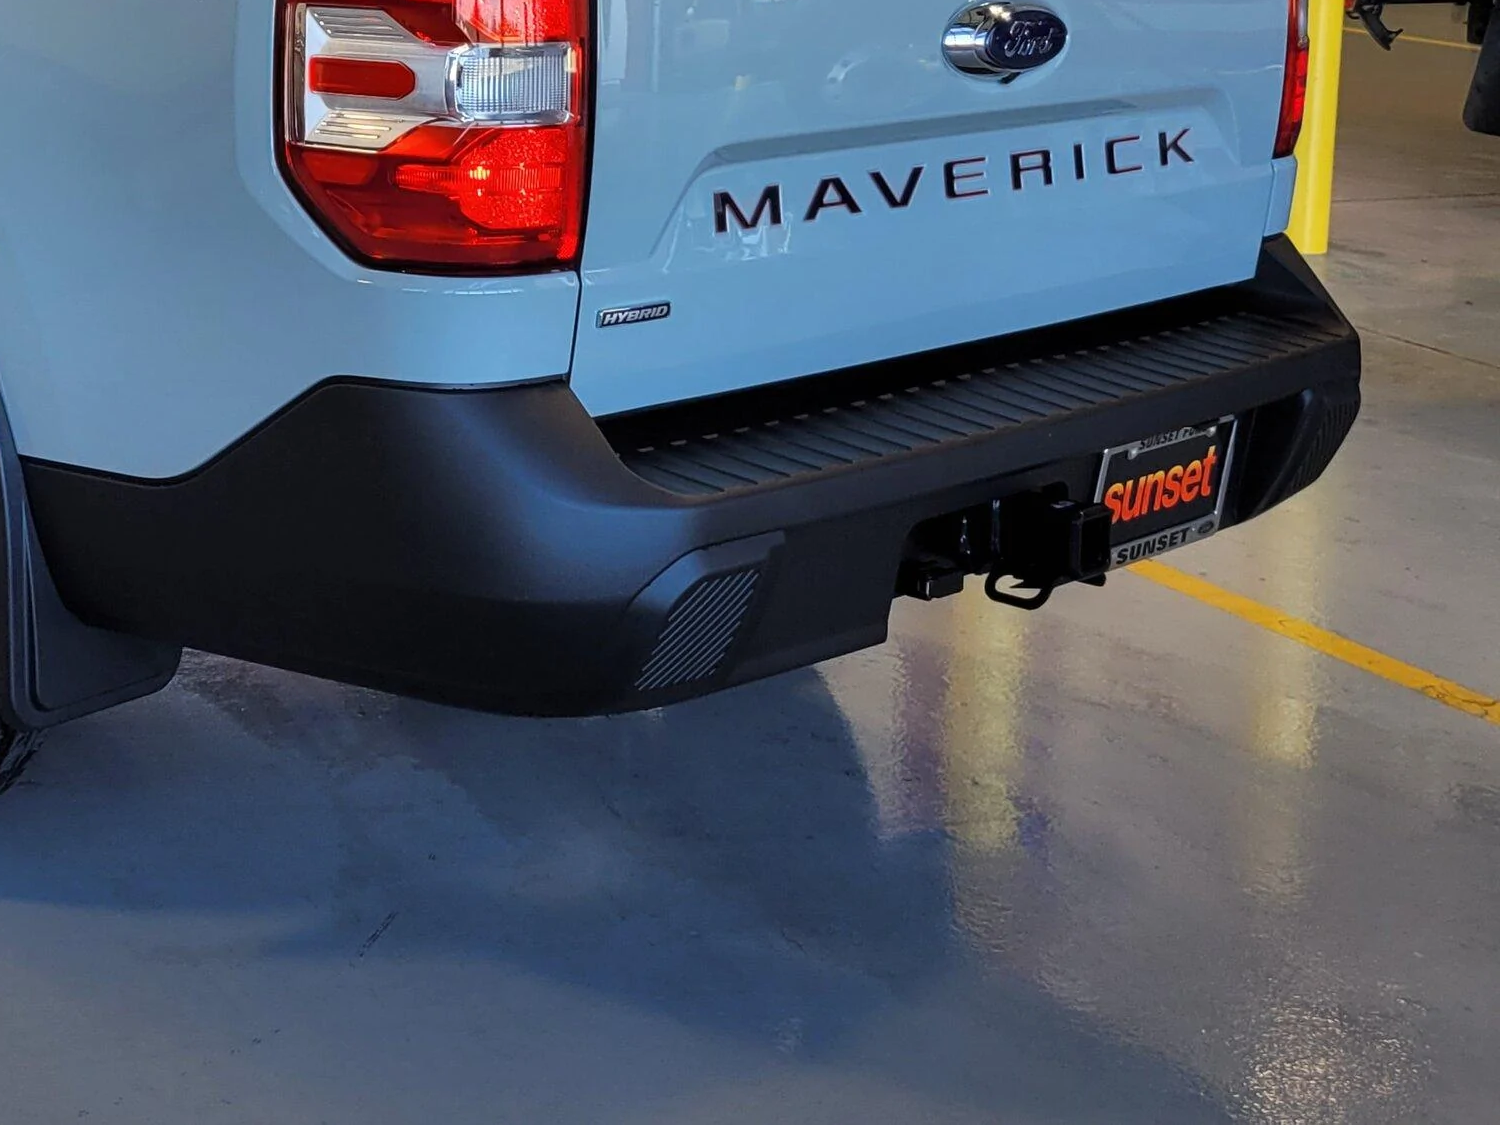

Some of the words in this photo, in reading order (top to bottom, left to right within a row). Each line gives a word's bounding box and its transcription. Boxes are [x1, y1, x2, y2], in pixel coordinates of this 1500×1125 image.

[1003, 20, 1054, 58] Ford
[712, 127, 1195, 234] MAVERICK
[602, 305, 669, 326] HYBRID
[1104, 445, 1218, 525] sunset
[1115, 527, 1190, 565] SUNSET
